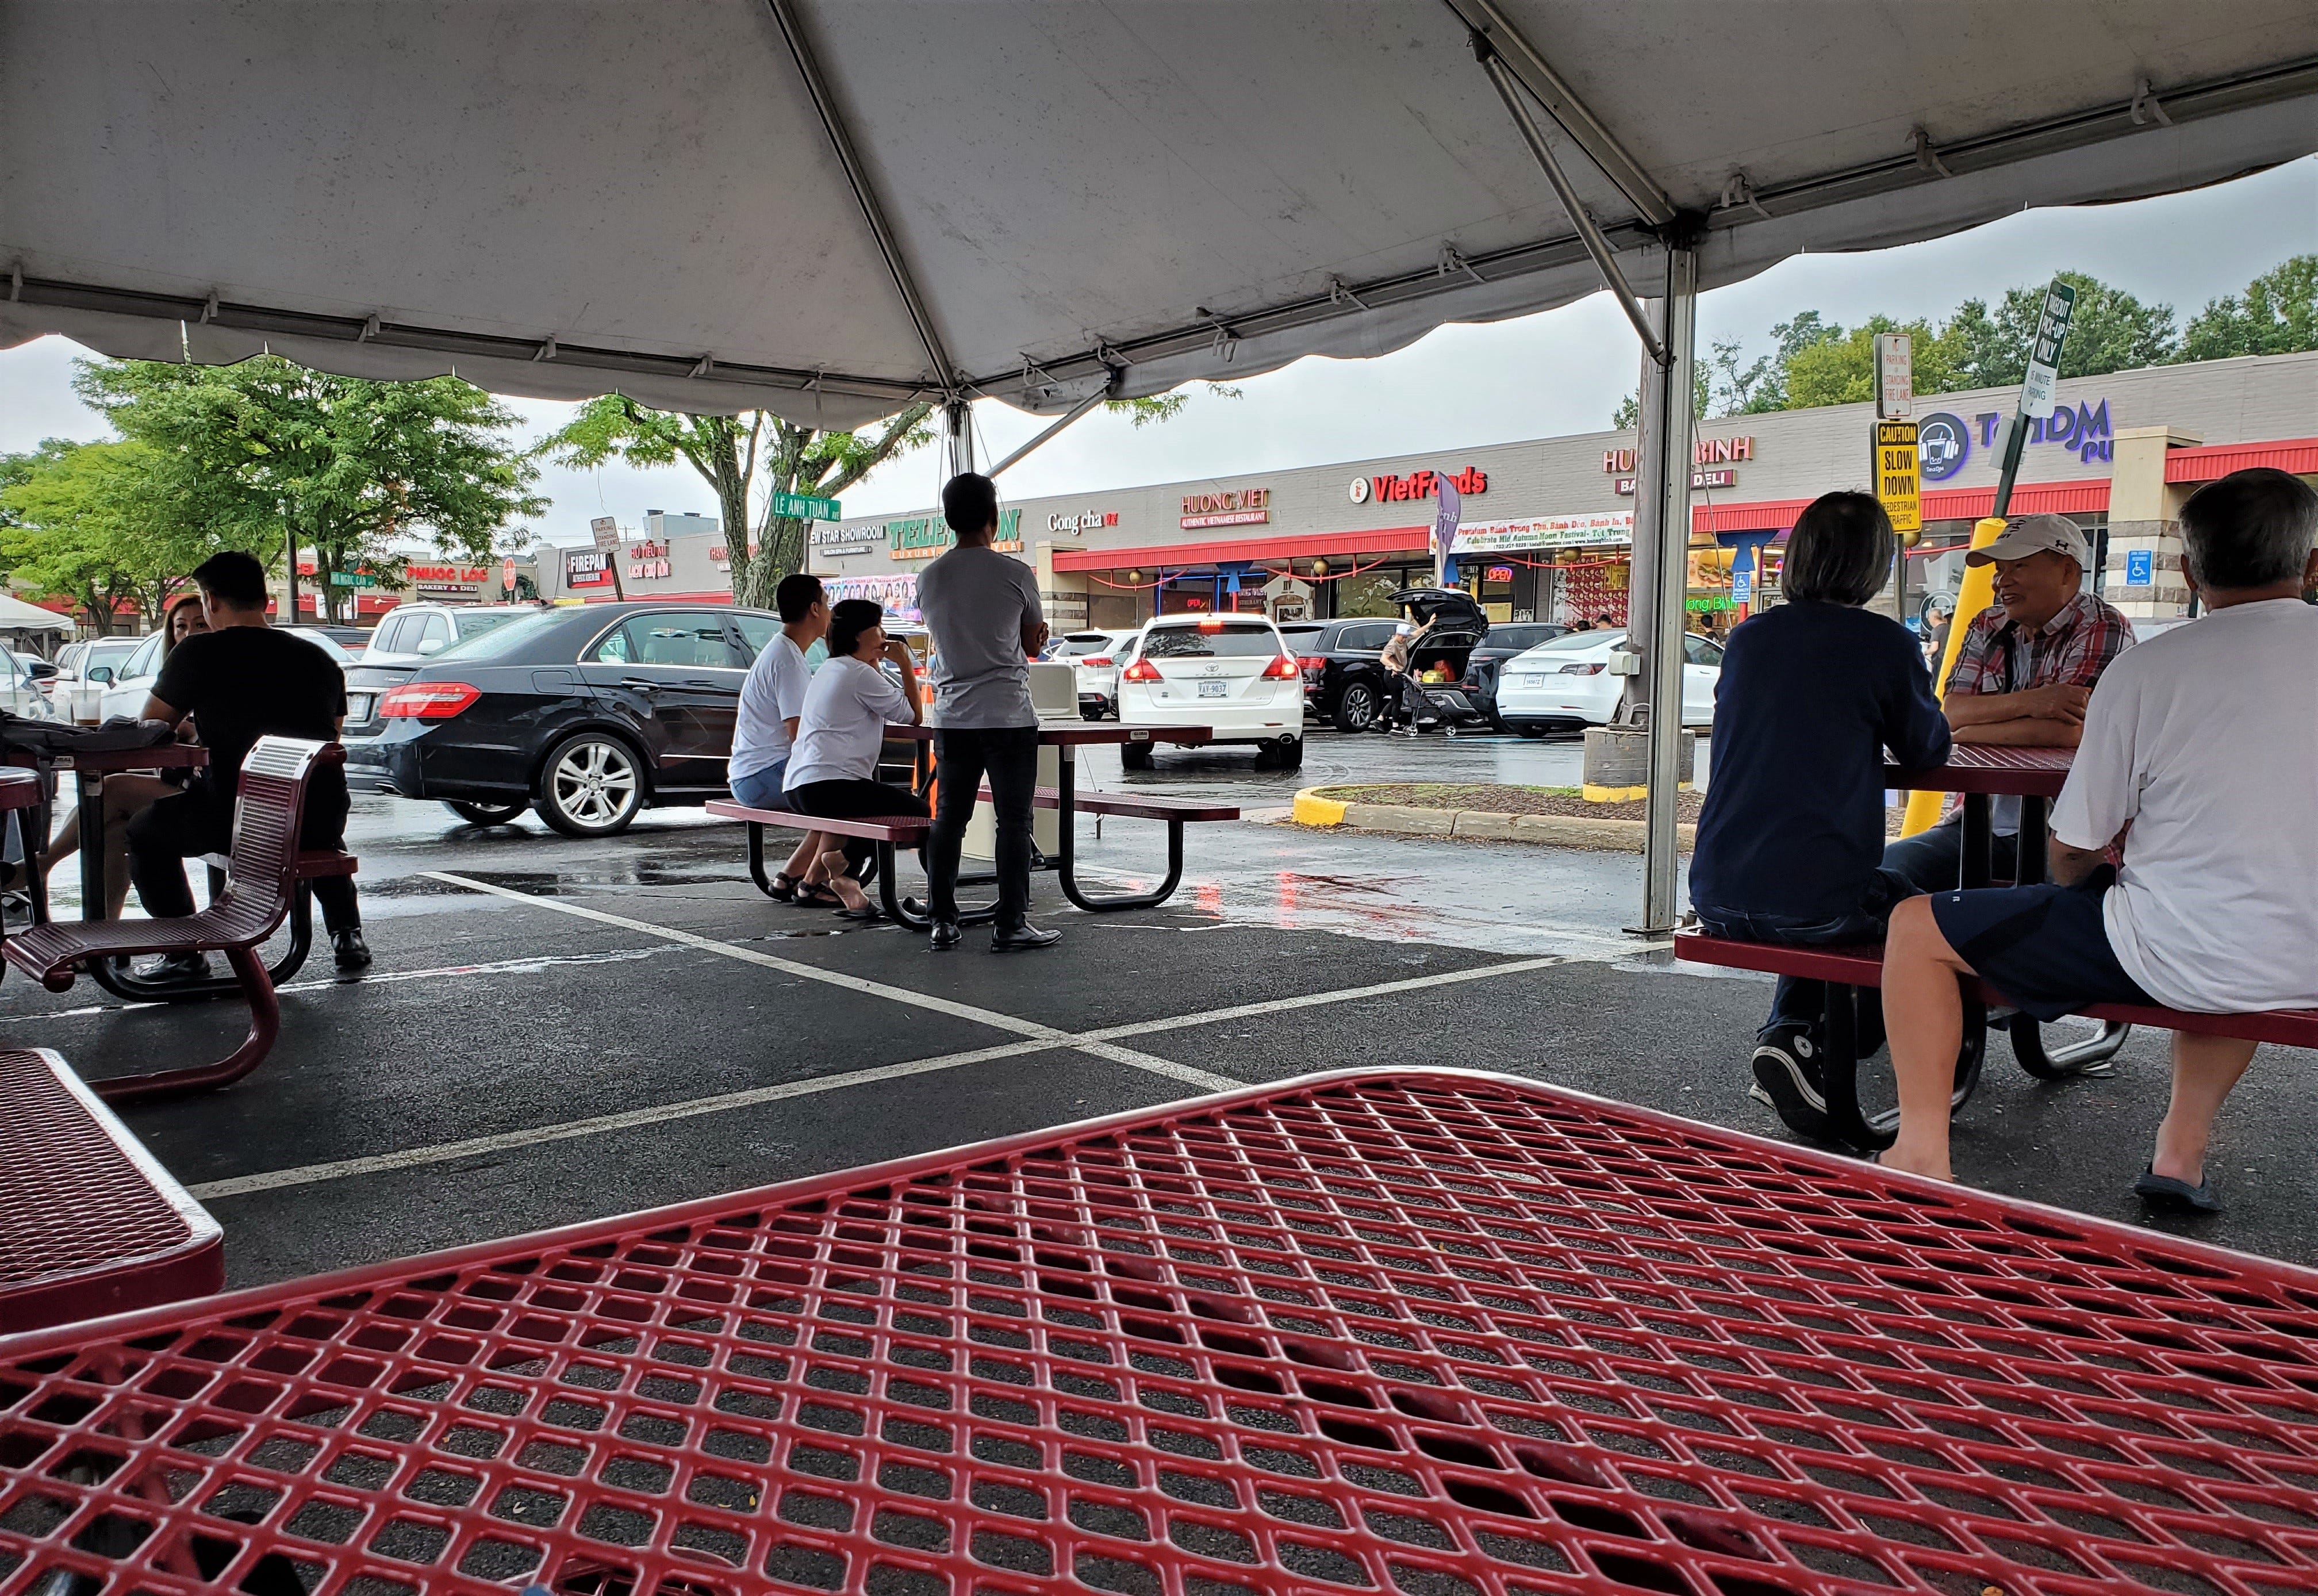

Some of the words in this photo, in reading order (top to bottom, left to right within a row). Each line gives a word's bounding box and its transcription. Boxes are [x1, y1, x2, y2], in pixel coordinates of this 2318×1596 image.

[2048, 294, 2070, 318] TAKEOUT
[2041, 315, 2066, 339] PICK-UP
[1892, 342, 1899, 351] NO
[2037, 337, 2058, 362] ONLY
[1886, 355, 1906, 365] PARKING
[1886, 375, 1908, 385] STANDING
[2035, 372, 2051, 386] MINUTE
[1886, 389, 1895, 401] FIRE
[1897, 389, 1909, 401] LANE
[2028, 386, 2046, 401] PARKING
[1880, 426, 1916, 442] CAUTION
[1695, 436, 1751, 464] BINH
[1885, 450, 1912, 471] SLOW
[1693, 472, 1725, 486] DELI
[1885, 475, 1914, 496] DOWN
[788, 499, 805, 516] ANH
[1181, 493, 1233, 513] HUONG
[1237, 489, 1268, 508] VIET
[1047, 514, 1079, 535] Gong
[1081, 509, 1103, 528] cha
[1181, 517, 1206, 527] AUTHENTIC
[1207, 515, 1234, 525] VIETNAMESE
[1235, 512, 1265, 523] RESTAURANT
[822, 530, 839, 543] STAR
[841, 526, 884, 542] SHOWROOM
[1458, 527, 1487, 536] Premium
[1509, 524, 1530, 533] Trung
[1499, 535, 1511, 543] Mid
[1513, 533, 1538, 542] Autumn
[1539, 531, 1557, 540] Moon
[1607, 528, 1630, 537] Trung
[892, 548, 937, 559] LUXURY
[570, 553, 607, 573] FIREPAN
[504, 568, 516, 581] STOP
[1488, 569, 1511, 580] OPEN
[1187, 599, 1200, 607] OPEN
